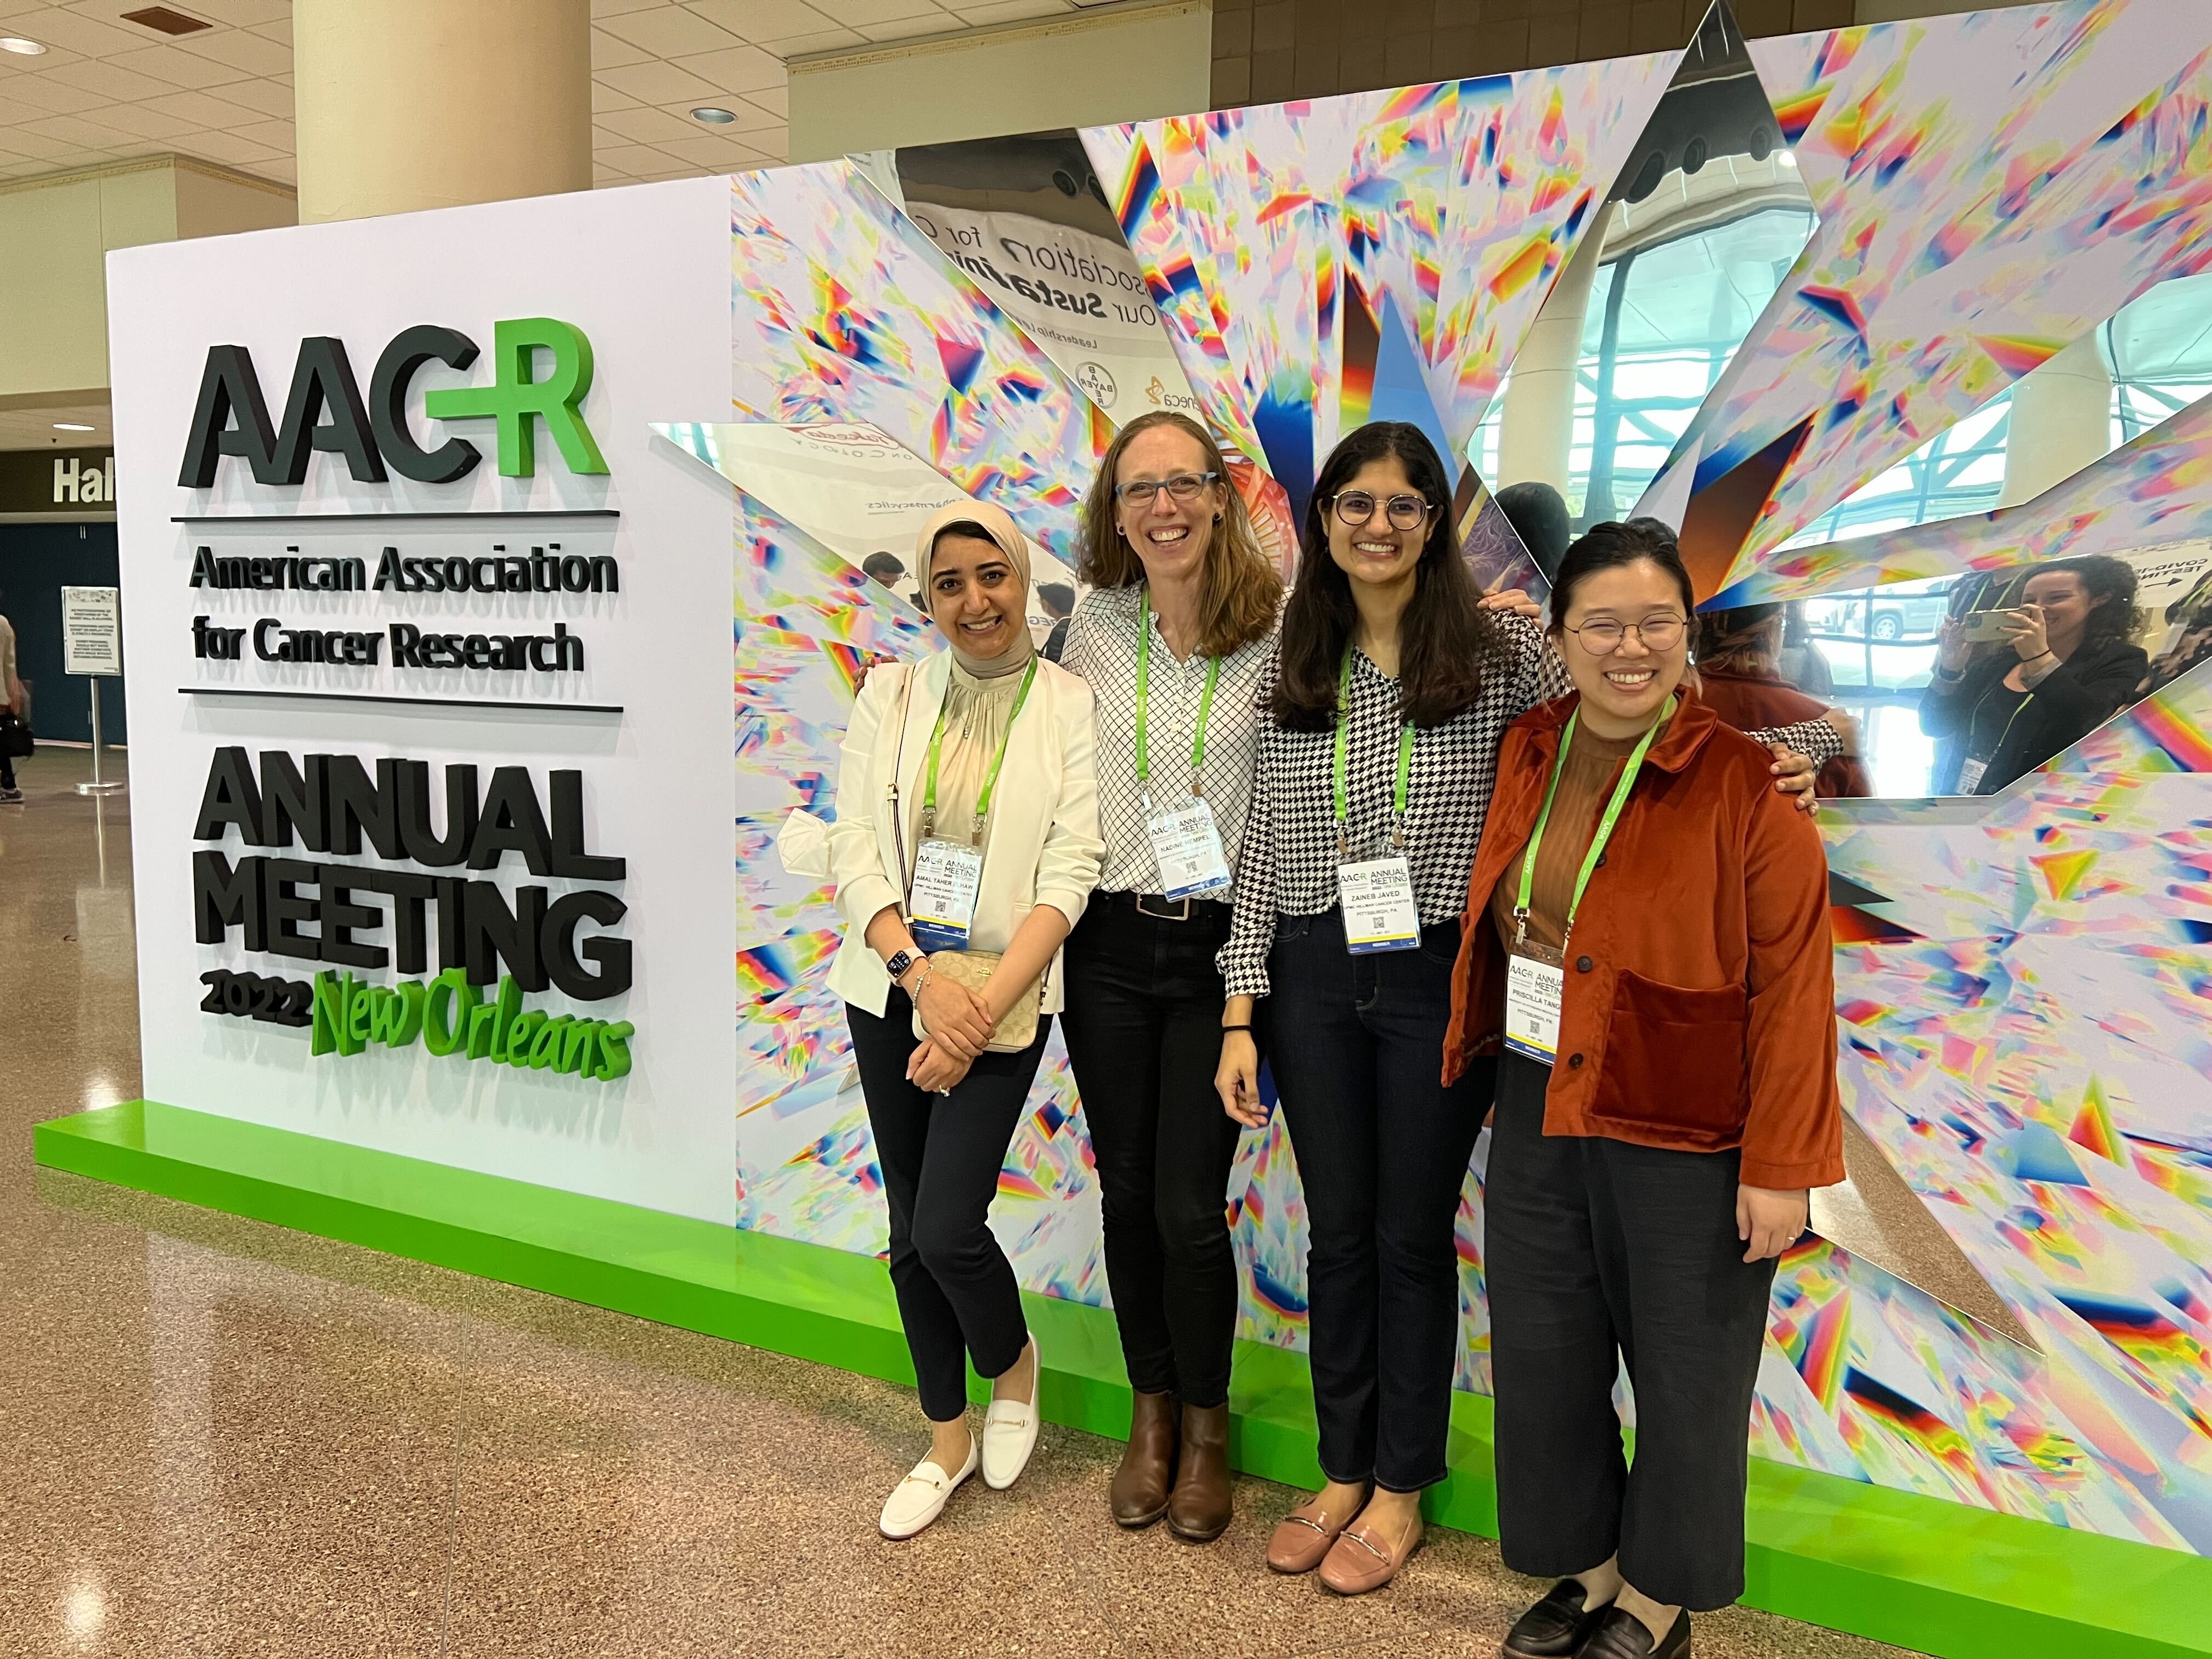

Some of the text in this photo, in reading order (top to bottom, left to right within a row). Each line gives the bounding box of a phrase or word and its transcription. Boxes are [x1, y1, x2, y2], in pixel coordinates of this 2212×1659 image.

[178, 318, 611, 488] AACR
[54, 456, 114, 503] Hal
[189, 544, 619, 592] American Association
[191, 616, 584, 672] for Cancer Research
[193, 746, 627, 881] ANNUAL
[1180, 814, 1210, 827] ANNUAL
[1180, 820, 1212, 834] MEETING
[1160, 842, 1183, 853] NADINE
[1185, 835, 1211, 844] HEMPEL
[918, 855, 943, 865] AACR
[946, 860, 977, 871] ANNUAL
[944, 866, 977, 877] MEETING
[1340, 873, 1367, 883] AACR
[1371, 868, 1406, 878] ANNUAL
[1371, 874, 1408, 885] MEETING
[1351, 890, 1400, 901] ZAINEB JAVED
[193, 850, 633, 1001] MEETING
[1510, 965, 1533, 979] AACR
[1513, 989, 1542, 1004] PRISCILLA
[200, 967, 635, 1082] 2022 New Orleans
